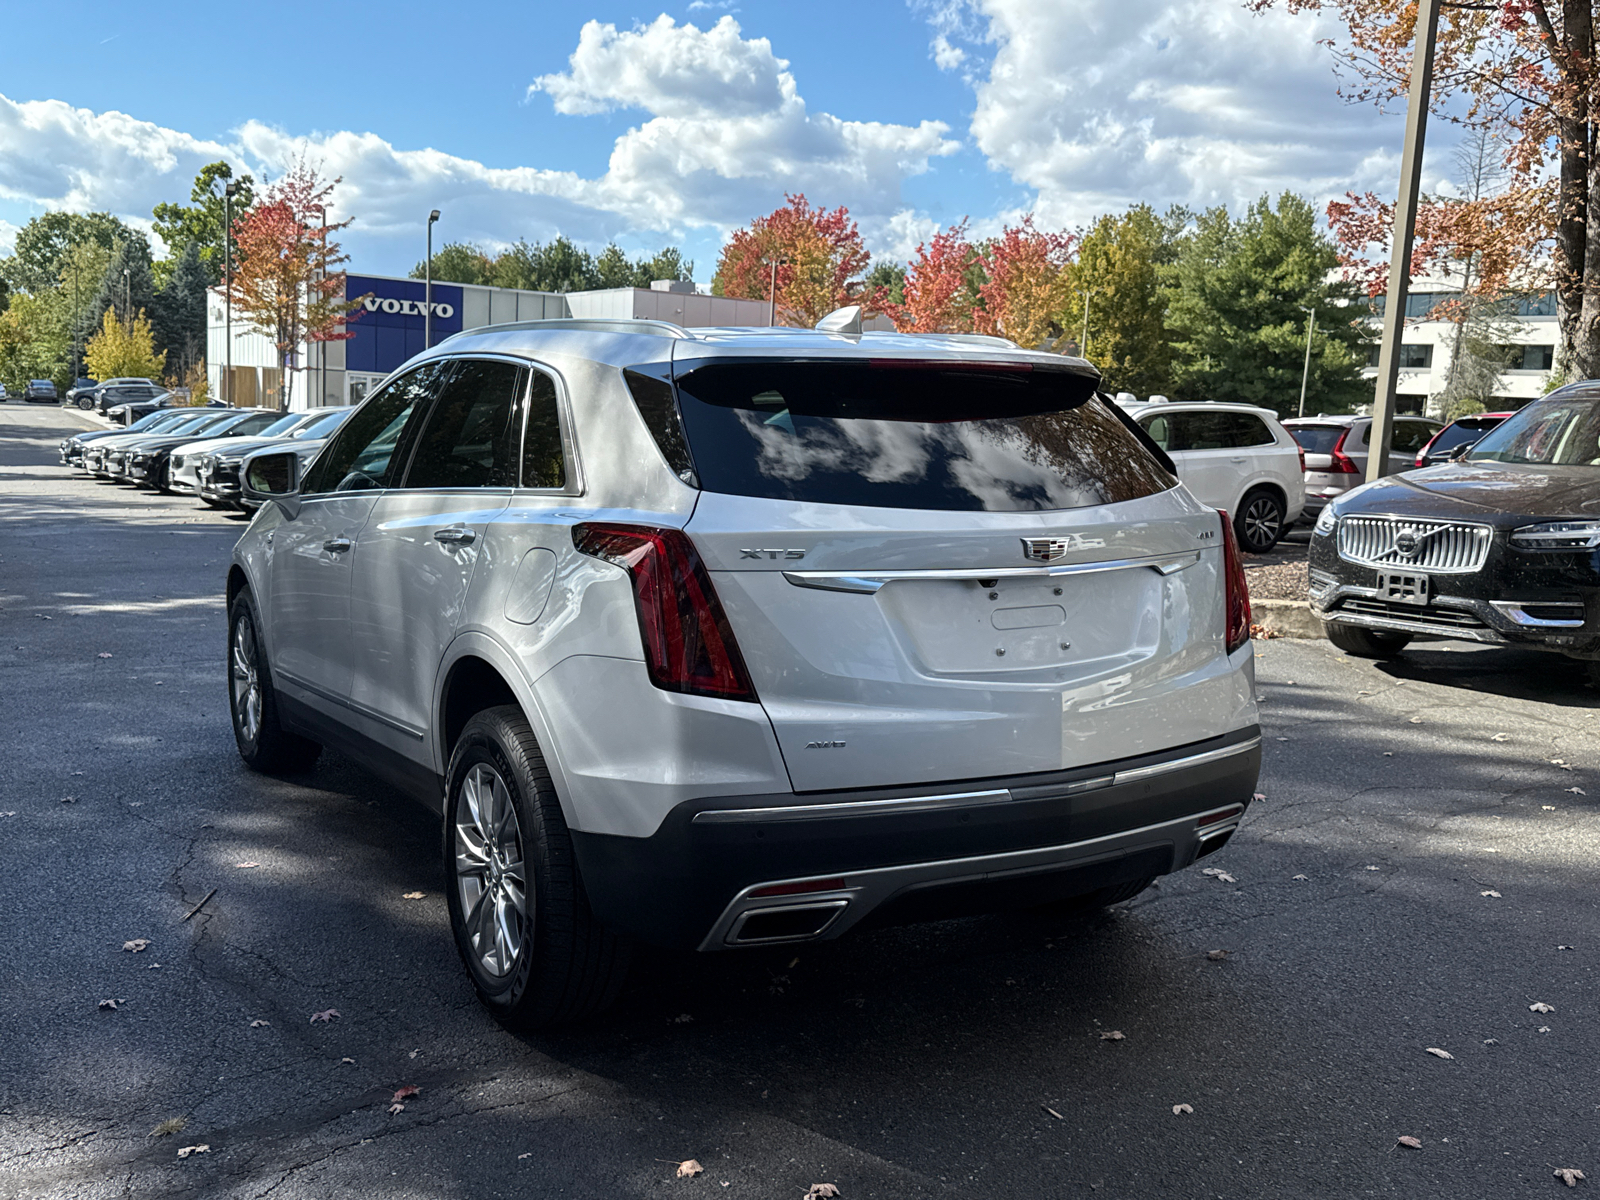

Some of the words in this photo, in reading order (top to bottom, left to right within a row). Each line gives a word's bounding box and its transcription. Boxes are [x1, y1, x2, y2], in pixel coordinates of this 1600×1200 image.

[364, 297, 454, 318] VOLVO
[740, 548, 806, 560] XT5
[804, 741, 846, 749] AWD
